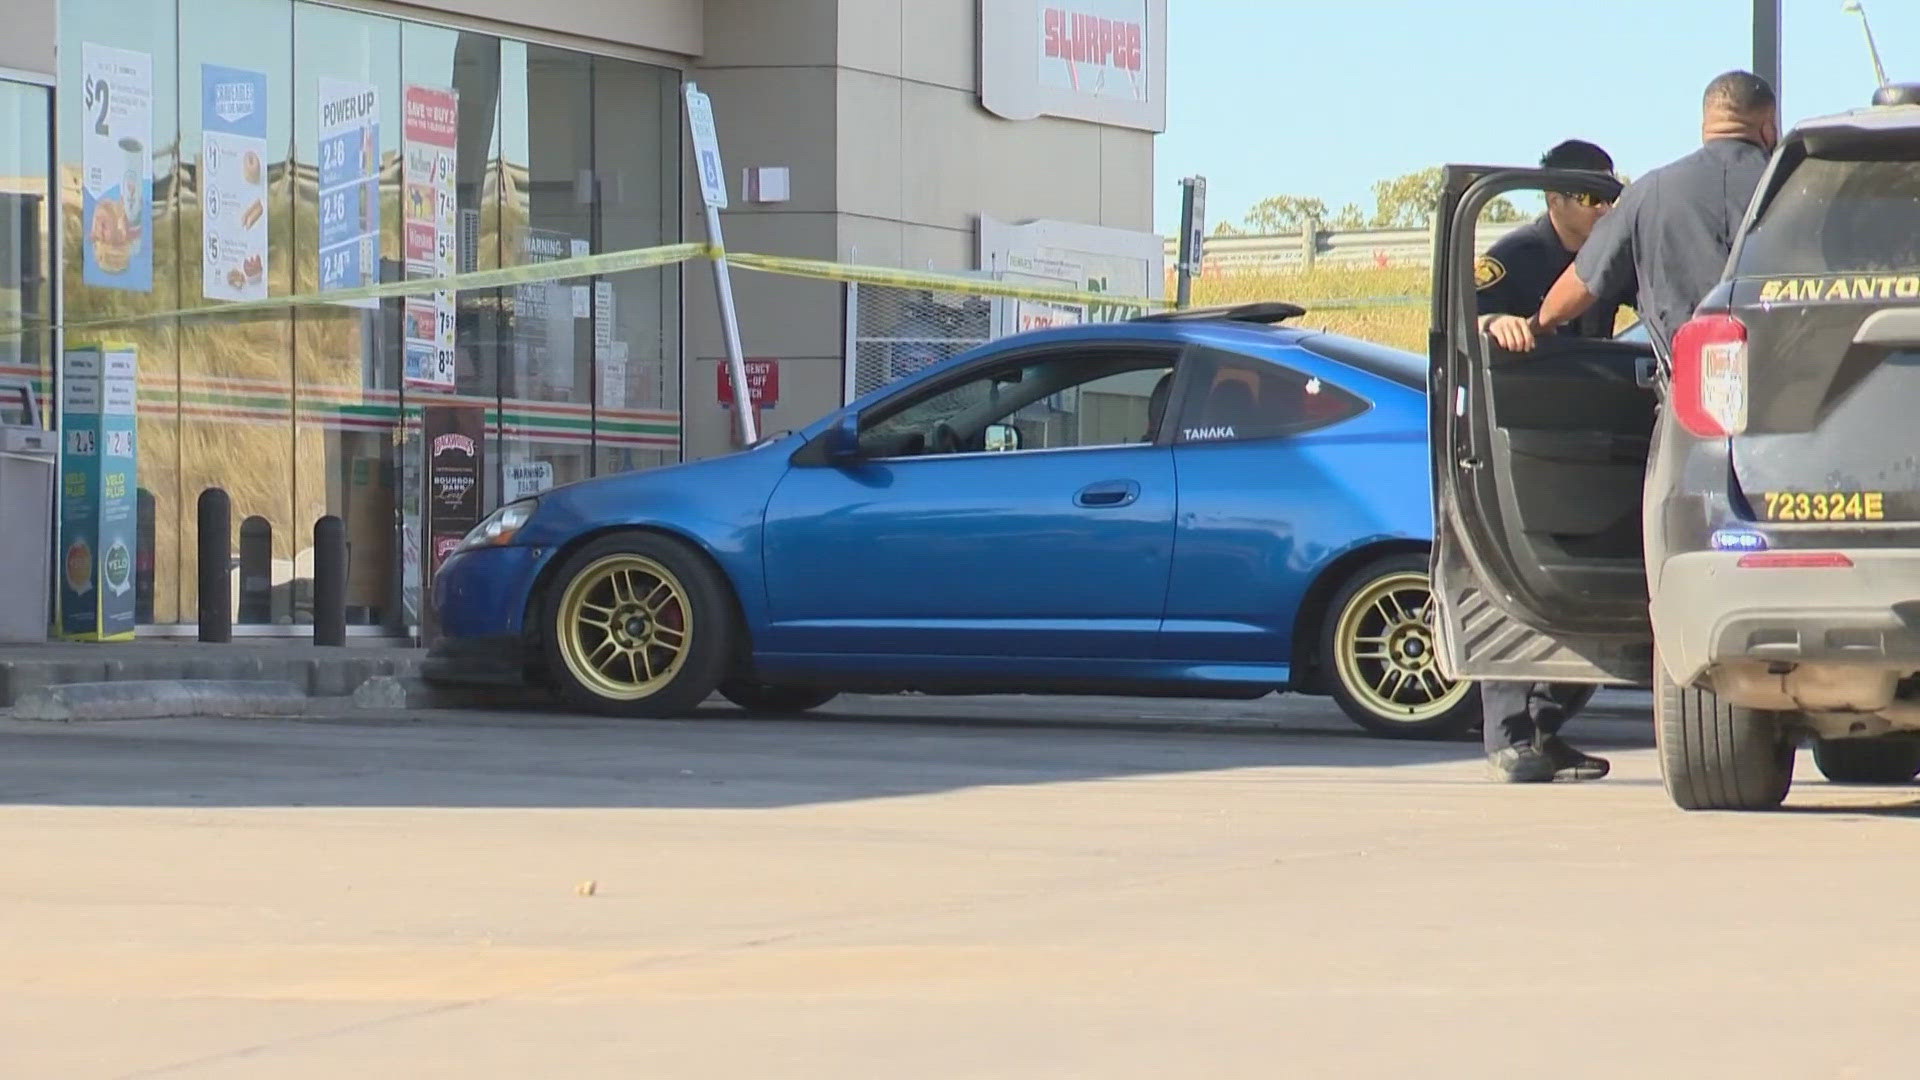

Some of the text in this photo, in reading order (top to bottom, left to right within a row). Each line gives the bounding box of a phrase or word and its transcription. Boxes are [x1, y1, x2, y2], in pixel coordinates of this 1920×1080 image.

[1044, 8, 1141, 71] SLURPEE
[85, 73, 109, 137] $2
[323, 91, 375, 127] POWER UP
[1759, 279, 1824, 302] SAN
[724, 363, 770, 375] EGENCY
[1183, 425, 1235, 441] TANAKA
[434, 476, 475, 485] BOURBON
[1764, 492, 1884, 520] 723324E
